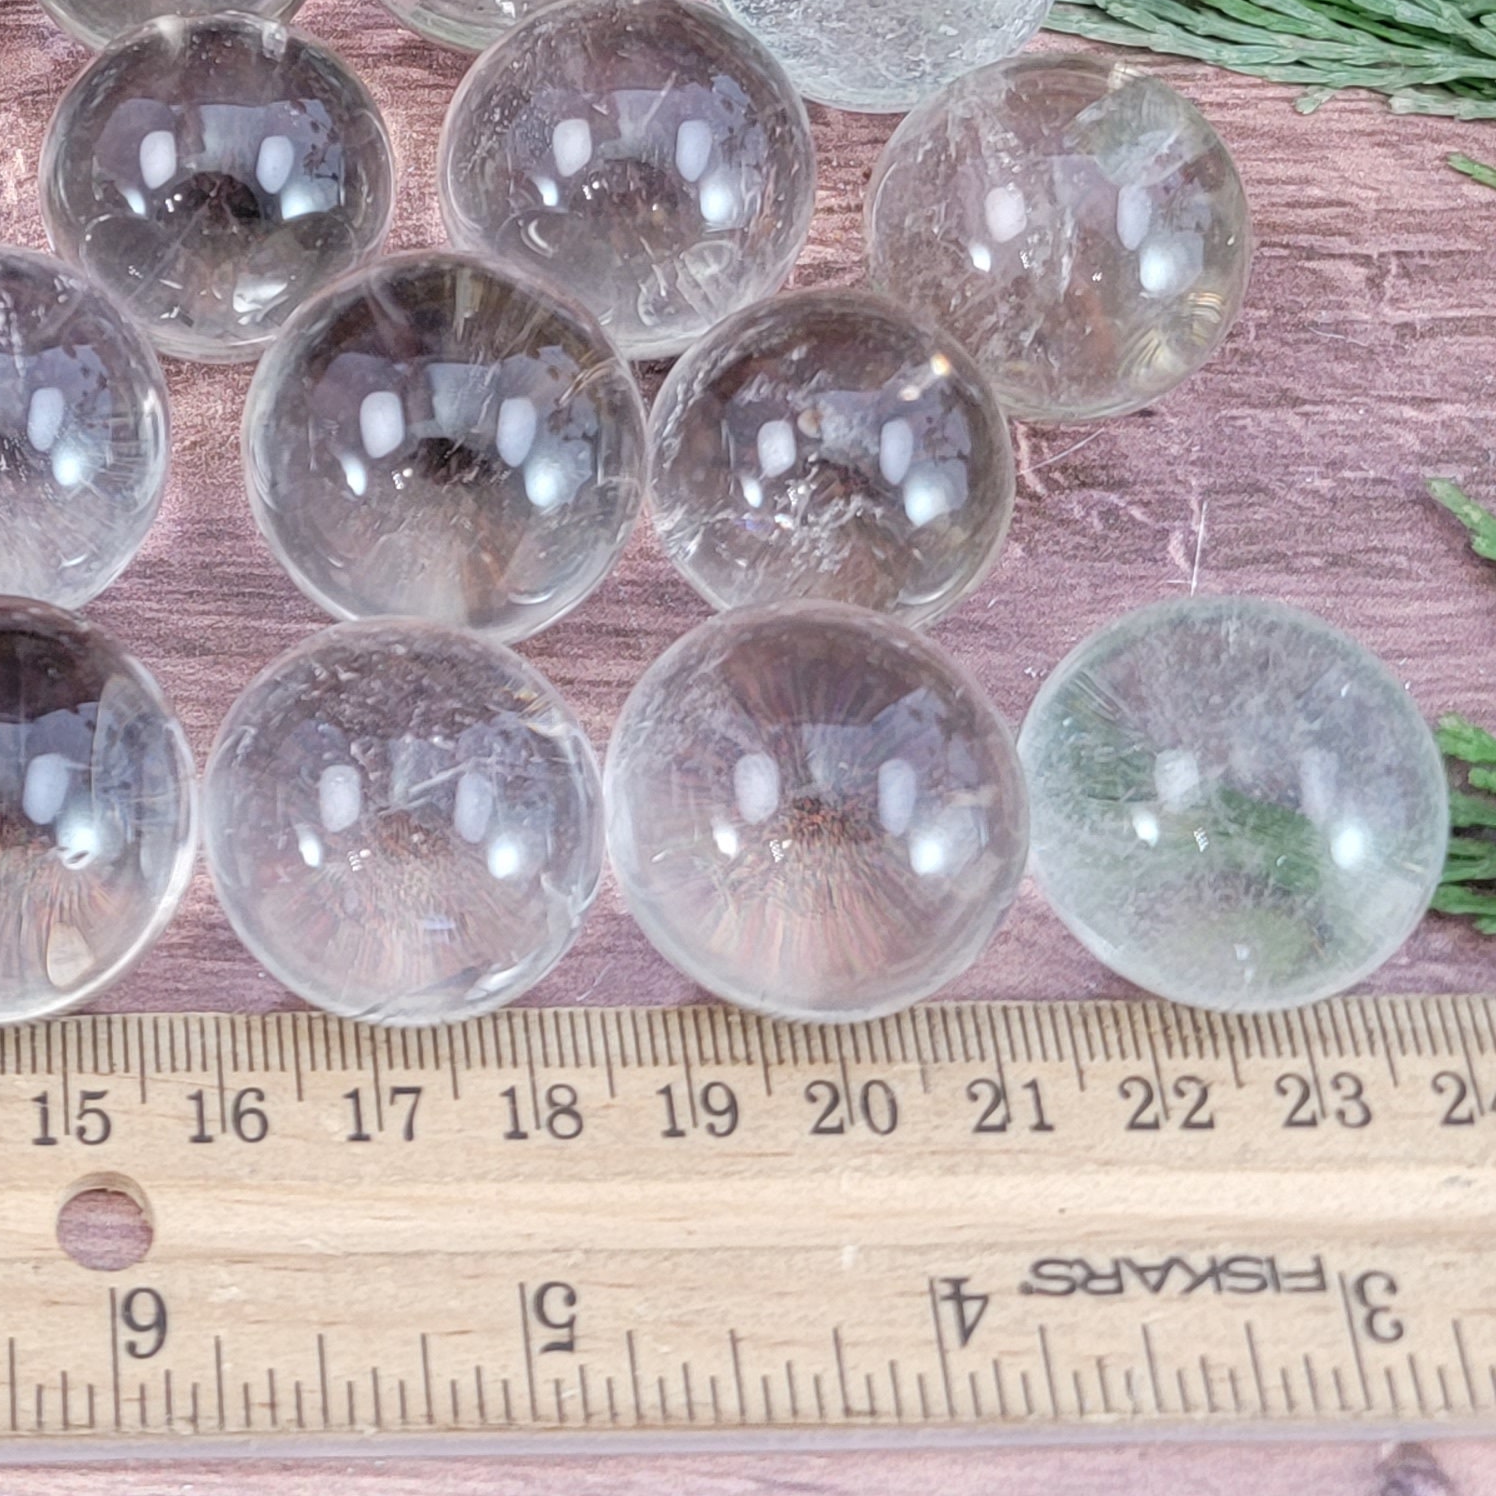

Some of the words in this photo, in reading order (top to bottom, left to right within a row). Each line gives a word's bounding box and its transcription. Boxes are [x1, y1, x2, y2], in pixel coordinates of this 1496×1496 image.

[31, 1089, 113, 1146] 15
[187, 1087, 270, 1143] 16
[344, 1085, 423, 1141] 17
[500, 1083, 584, 1140] 18
[656, 1081, 739, 1138] 19
[804, 1079, 899, 1135] 20
[966, 1077, 1055, 1133] 21
[1117, 1075, 1216, 1131] 22
[1274, 1072, 1373, 1129] 23
[1430, 1071, 1496, 1127] 2
[120, 1287, 168, 1359] 6
[533, 1281, 577, 1353] 5
[938, 1276, 990, 1347] 4
[1353, 1270, 1405, 1344] 3
